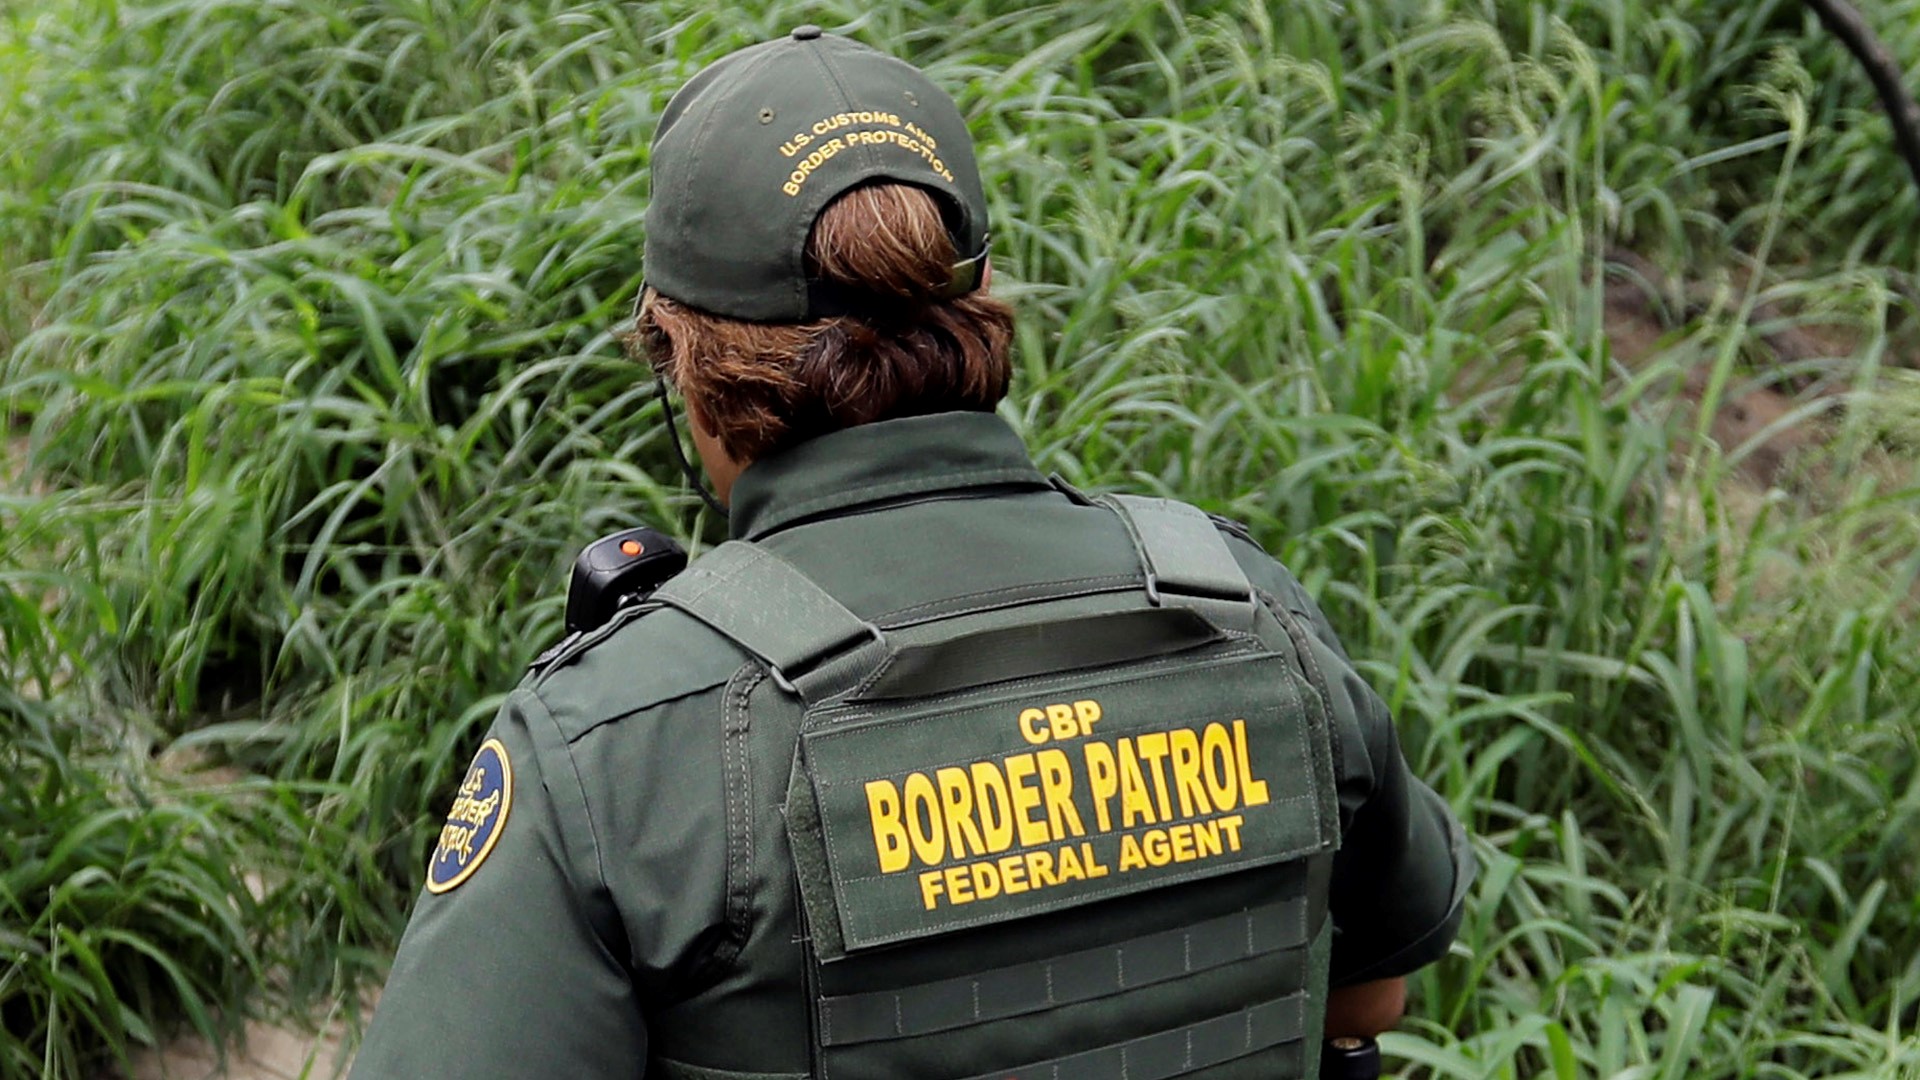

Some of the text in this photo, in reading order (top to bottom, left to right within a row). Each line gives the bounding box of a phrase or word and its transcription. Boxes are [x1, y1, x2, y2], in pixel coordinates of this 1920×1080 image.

[780, 111, 937, 157] U.S. CUSTOMS AND
[783, 130, 954, 197] BORDER PROTECTION
[1018, 699, 1102, 744] CBP
[865, 719, 1270, 874] BORDER PATROL
[918, 815, 1245, 911] FEDERAL AGENT
